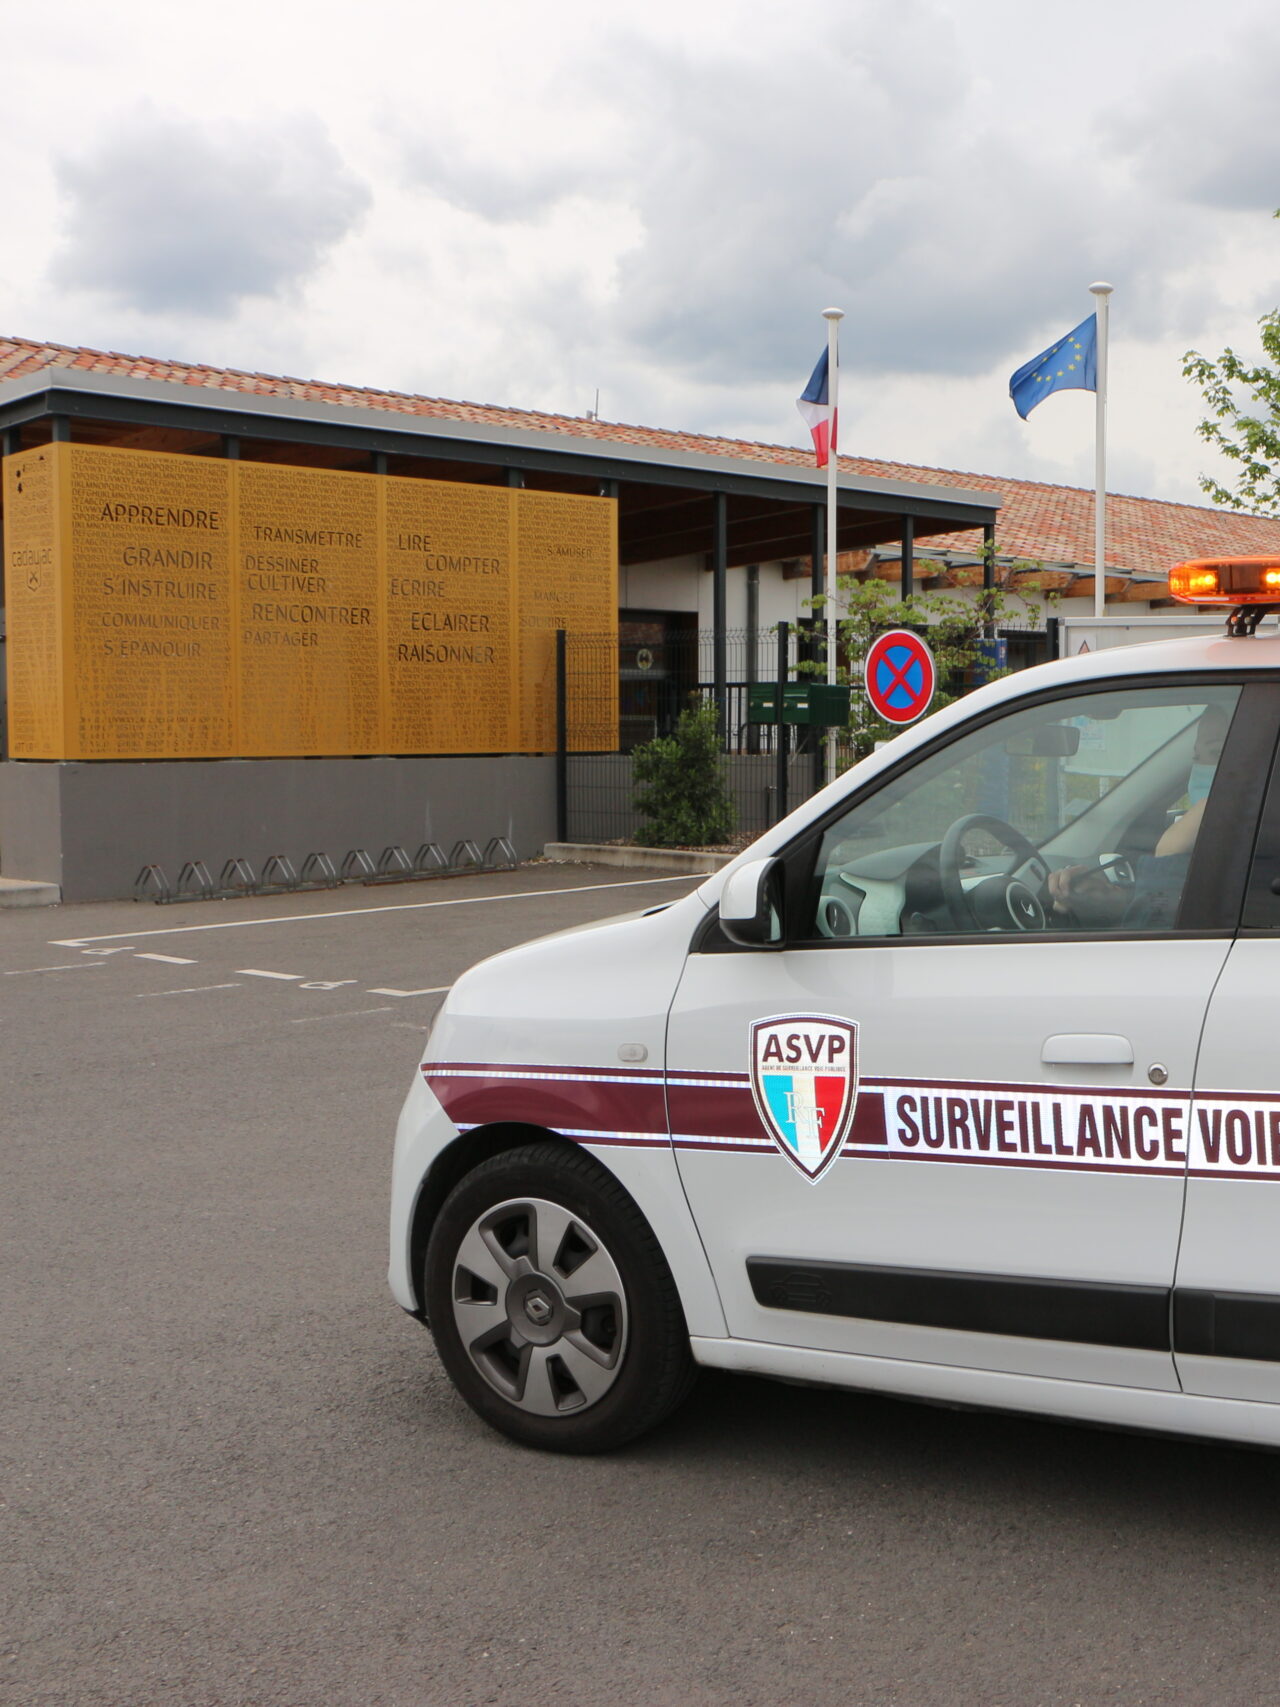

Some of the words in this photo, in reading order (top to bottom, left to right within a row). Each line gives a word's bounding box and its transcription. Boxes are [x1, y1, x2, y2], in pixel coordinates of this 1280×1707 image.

[100, 503, 219, 530] APPRENDRE
[253, 525, 363, 549] TRANSMETTRE
[398, 534, 432, 552] LIRE
[123, 546, 213, 570] GRANDIR
[245, 554, 319, 574] DESSINER
[425, 554, 500, 575] COMPTER
[247, 573, 326, 593] CULTIVER
[391, 577, 446, 598] ECRIRE
[102, 611, 220, 631] COMMUNIQUER
[251, 602, 370, 625] RENCONTRER
[411, 611, 489, 633] ECLAIRER
[242, 630, 319, 647] PARTAGER
[397, 643, 495, 664] RAISONNER
[762, 1033, 846, 1063] ASVP
[897, 1094, 1187, 1162] SURVEILLANCE
